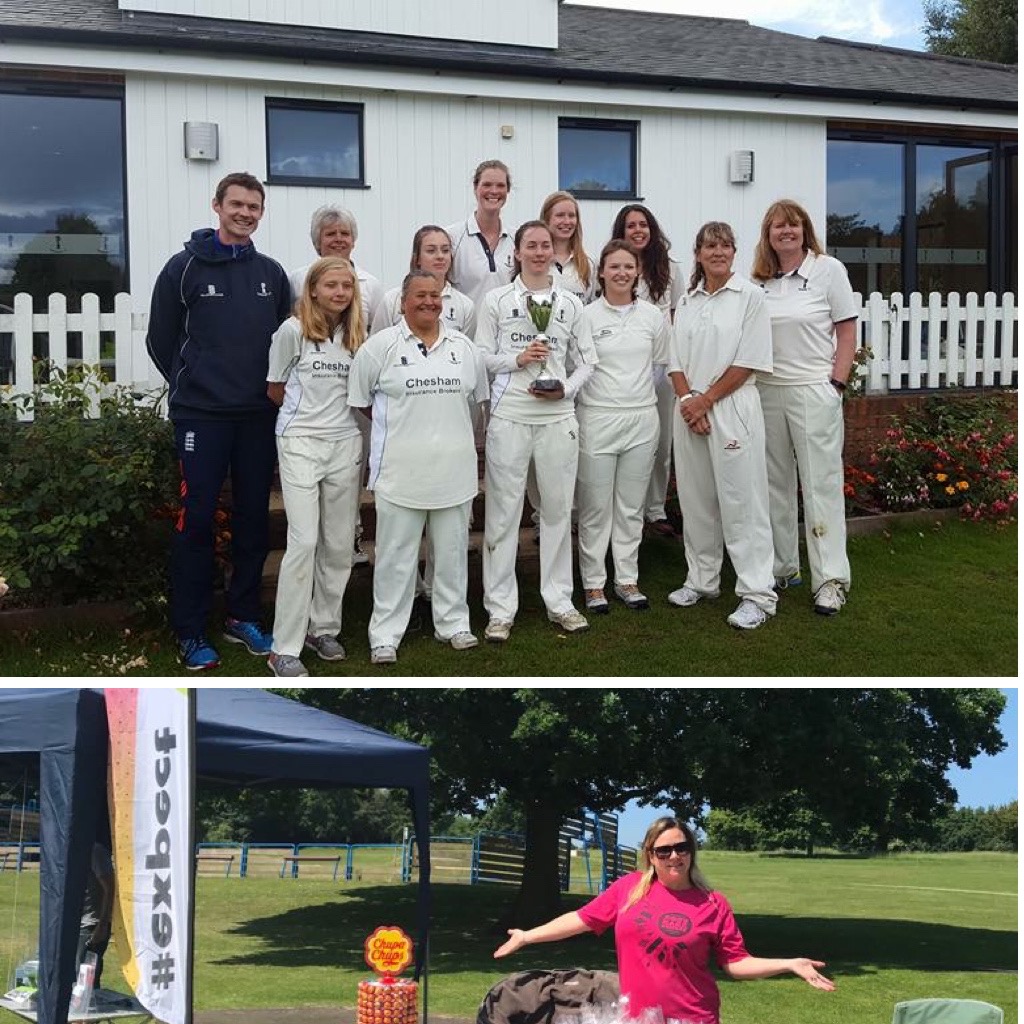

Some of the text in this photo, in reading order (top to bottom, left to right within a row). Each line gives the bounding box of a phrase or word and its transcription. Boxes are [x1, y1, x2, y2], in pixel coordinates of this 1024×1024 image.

[312, 360, 350, 371] Chesha
[405, 376, 462, 389] Chesham
[373, 938, 406, 950] Chupa
[371, 950, 404, 961] Chups
